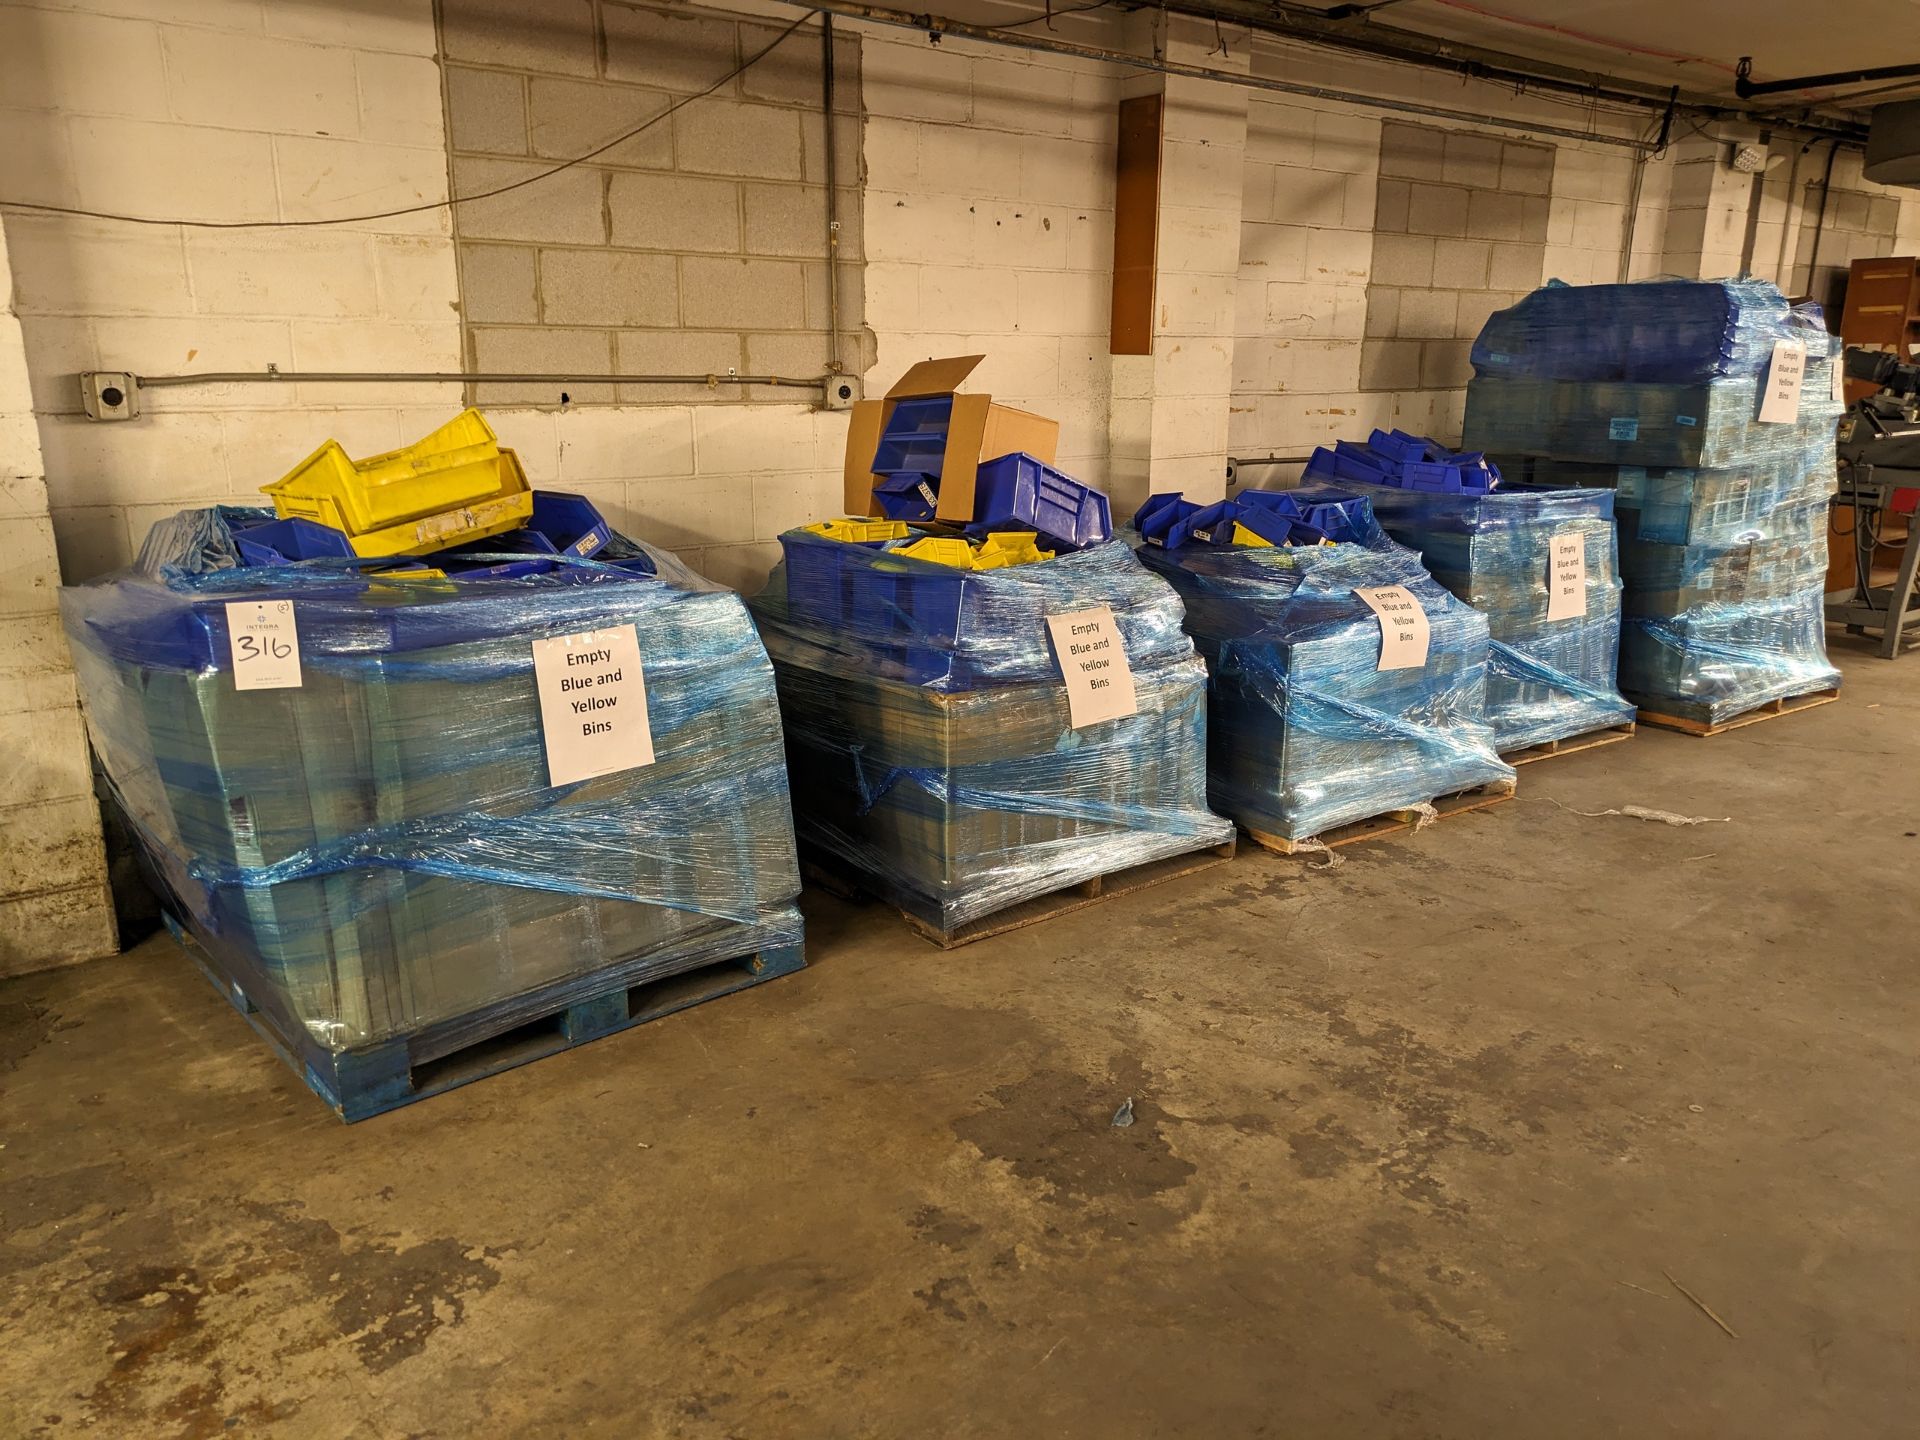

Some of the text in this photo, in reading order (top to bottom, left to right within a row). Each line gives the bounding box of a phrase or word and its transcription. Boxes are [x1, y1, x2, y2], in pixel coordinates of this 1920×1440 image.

[1783, 351, 1798, 361] Empty
[1777, 364, 1799, 374] Blue and
[1778, 379, 1794, 387] Yellow
[1778, 392, 1789, 400] Bins
[1559, 545, 1576, 554] Empty
[1557, 558, 1579, 569] Blue and
[1560, 573, 1577, 582] Yellow
[1374, 590, 1400, 600] Empty
[1563, 587, 1575, 595] Bins
[1381, 602, 1413, 611] Blue and
[1392, 616, 1415, 626] Yellow
[1071, 621, 1100, 636] Empty
[1399, 632, 1414, 641] Bins
[237, 635, 292, 662] 316
[1070, 637, 1110, 655] Blue and
[566, 649, 611, 666] Empty
[1080, 658, 1110, 672] Yellow
[561, 668, 623, 692] Blue and
[1090, 679, 1110, 690] Bins
[571, 696, 617, 714] Yellow
[582, 721, 612, 736] Bins
